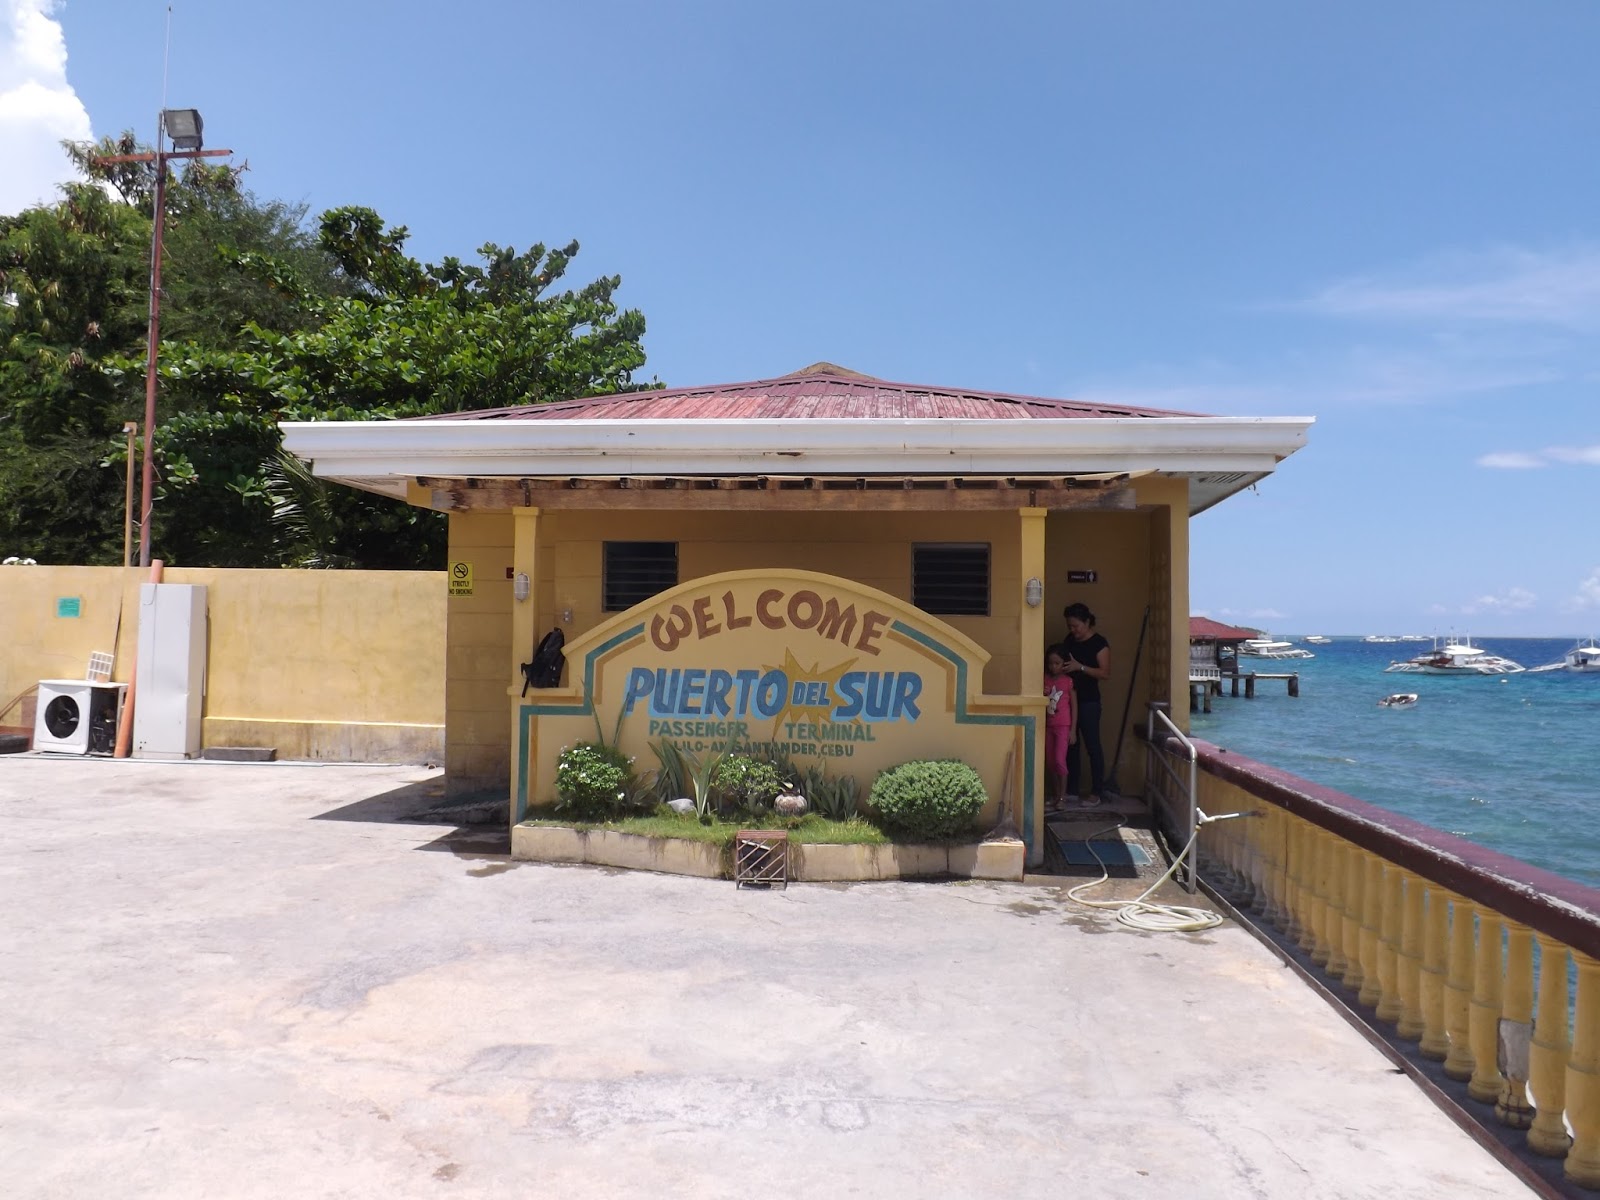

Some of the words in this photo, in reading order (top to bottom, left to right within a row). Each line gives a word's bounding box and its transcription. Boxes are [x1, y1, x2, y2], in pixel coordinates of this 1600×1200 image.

[650, 588, 892, 656] WELCOME
[624, 667, 789, 720] PUERTO
[791, 680, 832, 707] DEL
[832, 670, 924, 722] SUR
[648, 719, 750, 739] PASSENGER
[784, 721, 876, 743] TERMINAL
